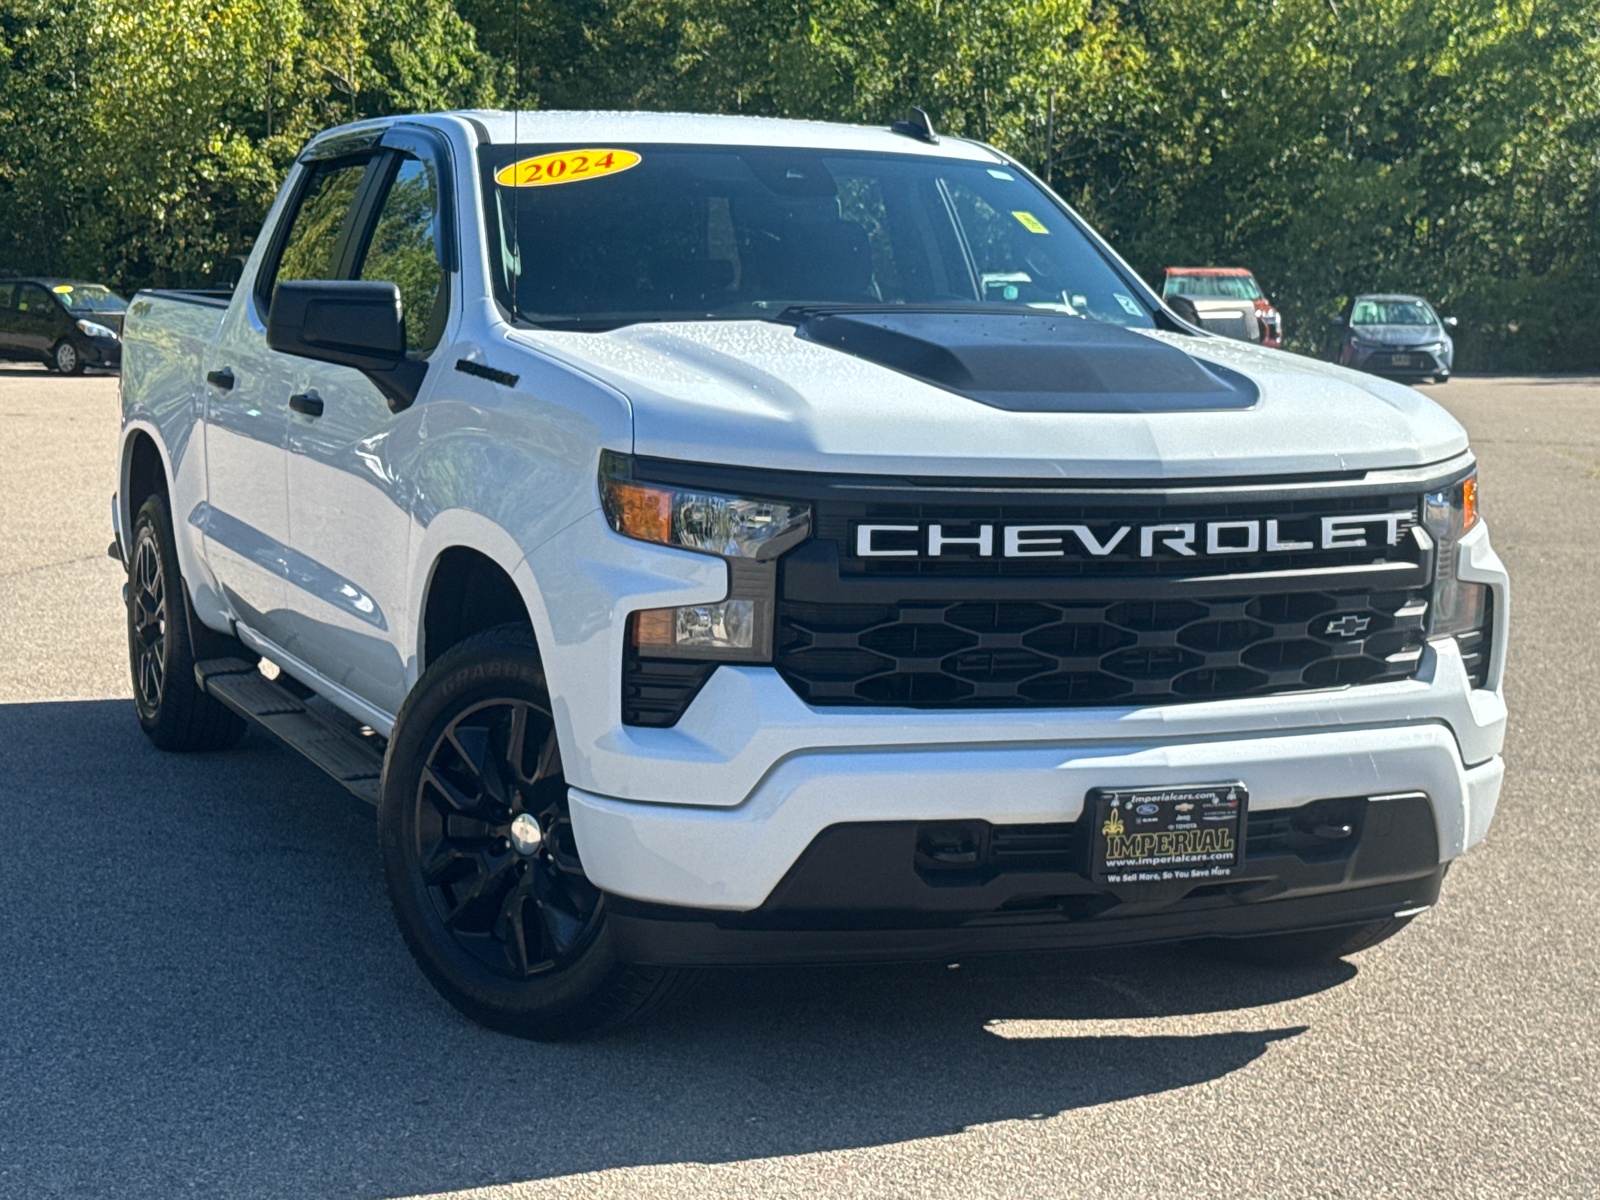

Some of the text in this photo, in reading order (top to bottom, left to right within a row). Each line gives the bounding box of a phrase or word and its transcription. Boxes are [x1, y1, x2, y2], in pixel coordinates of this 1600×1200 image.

[524, 152, 615, 183] 2024
[856, 511, 1416, 557] CHEVROLET
[1175, 822, 1198, 830] TOYOTA
[1106, 828, 1235, 859] IMPERIAL
[1106, 852, 1234, 868] www.imperialcars.com
[1107, 866, 1231, 883] We Sell More, So You Save More
